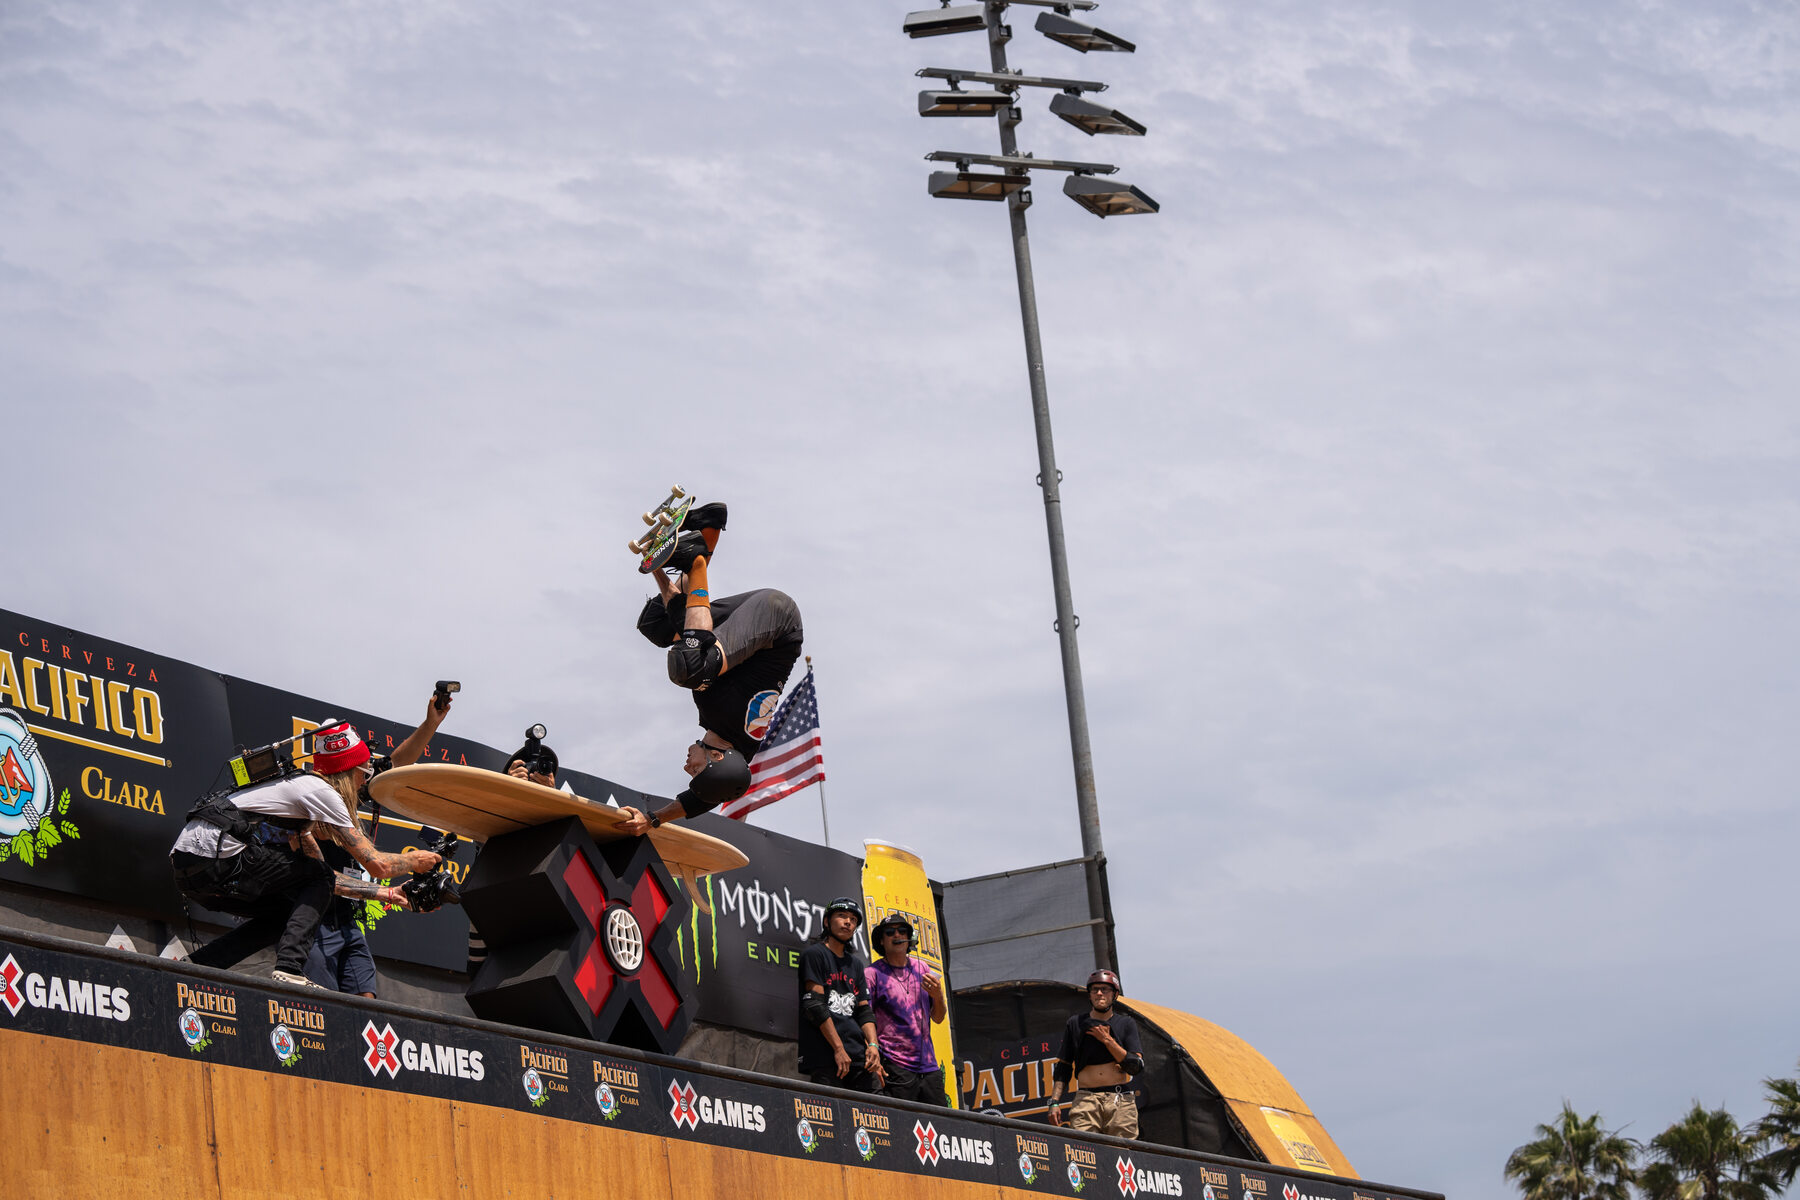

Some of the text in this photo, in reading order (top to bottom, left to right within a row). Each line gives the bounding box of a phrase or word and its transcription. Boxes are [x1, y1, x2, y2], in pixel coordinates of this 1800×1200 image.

[19, 632, 158, 683] CERVEZA
[0, 648, 164, 744] ACIFICO
[330, 740, 344, 750] 66
[351, 725, 467, 766] EREZA
[81, 766, 166, 815] CLARA
[719, 878, 870, 959] MONSTR
[884, 893, 933, 916] CERVEZ
[747, 941, 800, 968] ENE
[26, 972, 131, 1022] GAMES
[176, 982, 237, 1015] PACIFICO
[211, 1021, 237, 1036] CLARA
[268, 999, 325, 1030] PACIFICO
[301, 1037, 326, 1051] CLARA
[401, 1039, 485, 1081] GAMES
[520, 1045, 568, 1074] PACIFICO
[548, 1080, 569, 1093] CLARA
[592, 1060, 639, 1088] PACIFICO
[962, 1057, 1079, 1110] PACIF
[619, 1094, 640, 1106] CLARA
[794, 1097, 833, 1122] PACIFICO
[699, 1096, 766, 1133] GAMES
[852, 1107, 890, 1130] PACIFICO
[938, 1134, 994, 1166] GAMES
[1015, 1134, 1049, 1156] PACIFICO
[1064, 1143, 1097, 1165] PACIFICO
[1136, 1168, 1183, 1197] GAMES
[1199, 1166, 1228, 1186] PACIFICO
[1240, 1173, 1267, 1192] PACIFICO
